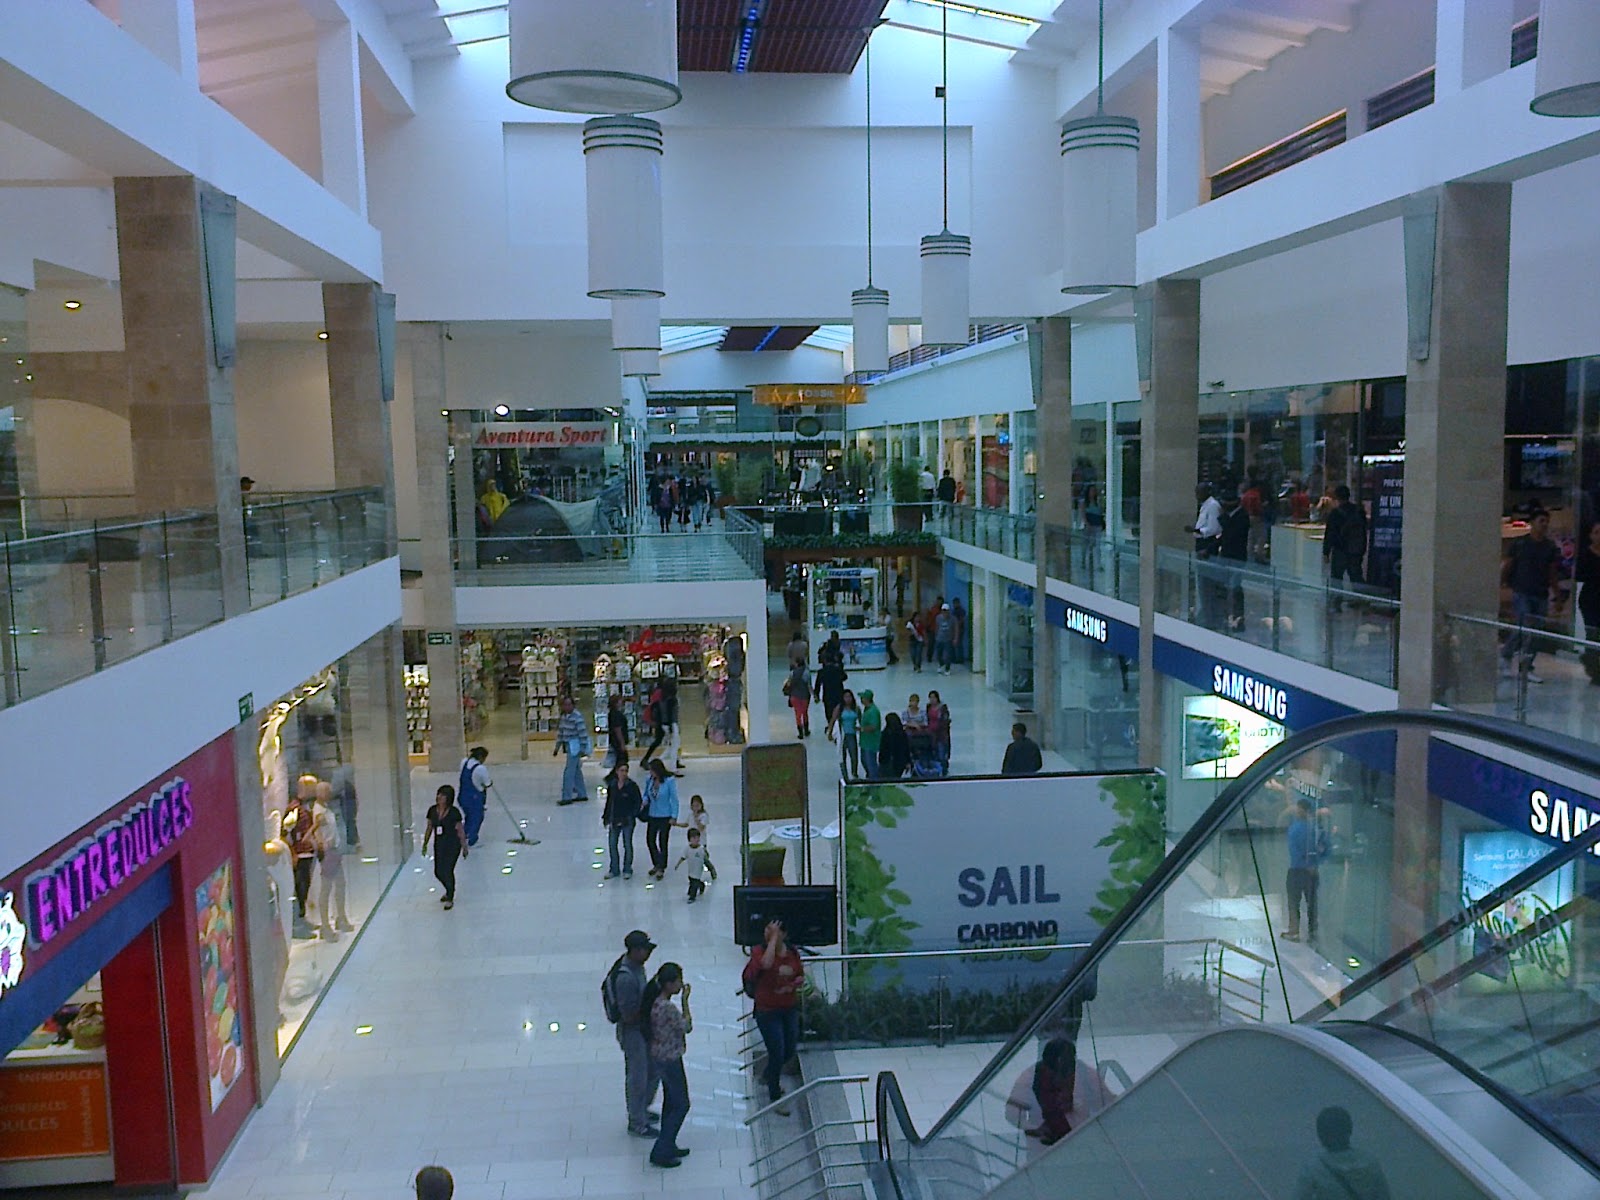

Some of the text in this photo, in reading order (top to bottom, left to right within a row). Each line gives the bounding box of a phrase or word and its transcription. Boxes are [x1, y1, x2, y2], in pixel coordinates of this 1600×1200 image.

[476, 425, 607, 446] Aventura Sport
[1065, 607, 1107, 643] SAMSUNG
[1212, 664, 1288, 720] SAMSUNG
[1530, 790, 1600, 856] SAM
[31, 778, 193, 945] ENTREDULCES
[958, 865, 1060, 908] SAIL
[957, 919, 1058, 943] CARBONO
